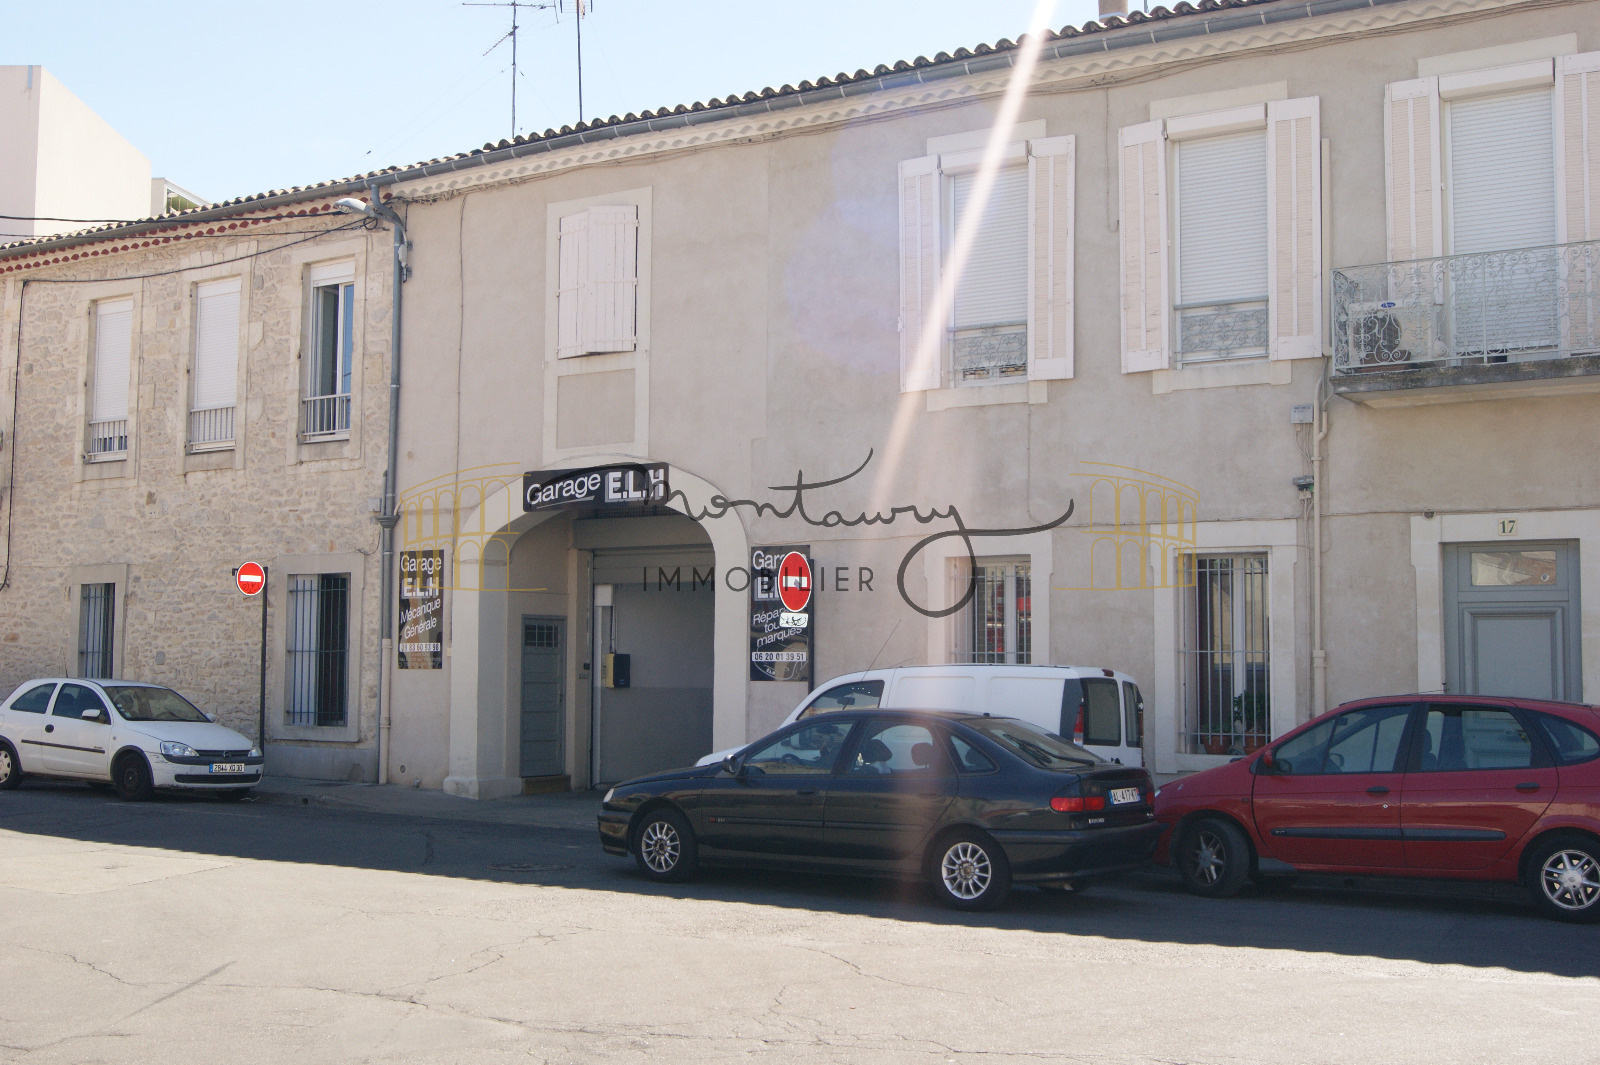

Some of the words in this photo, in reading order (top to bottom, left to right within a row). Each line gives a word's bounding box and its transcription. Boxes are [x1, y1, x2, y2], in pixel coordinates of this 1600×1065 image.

[526, 473, 601, 505] Garage
[1499, 519, 1516, 534] 17
[401, 555, 442, 574] Garage
[400, 598, 441, 624] Mécanique
[404, 616, 437, 639] Générale
[756, 626, 803, 648] marques
[754, 652, 763, 661] 06
[765, 652, 774, 661] 20
[775, 652, 784, 661] 01
[786, 652, 795, 661] 39
[796, 652, 804, 661] 51
